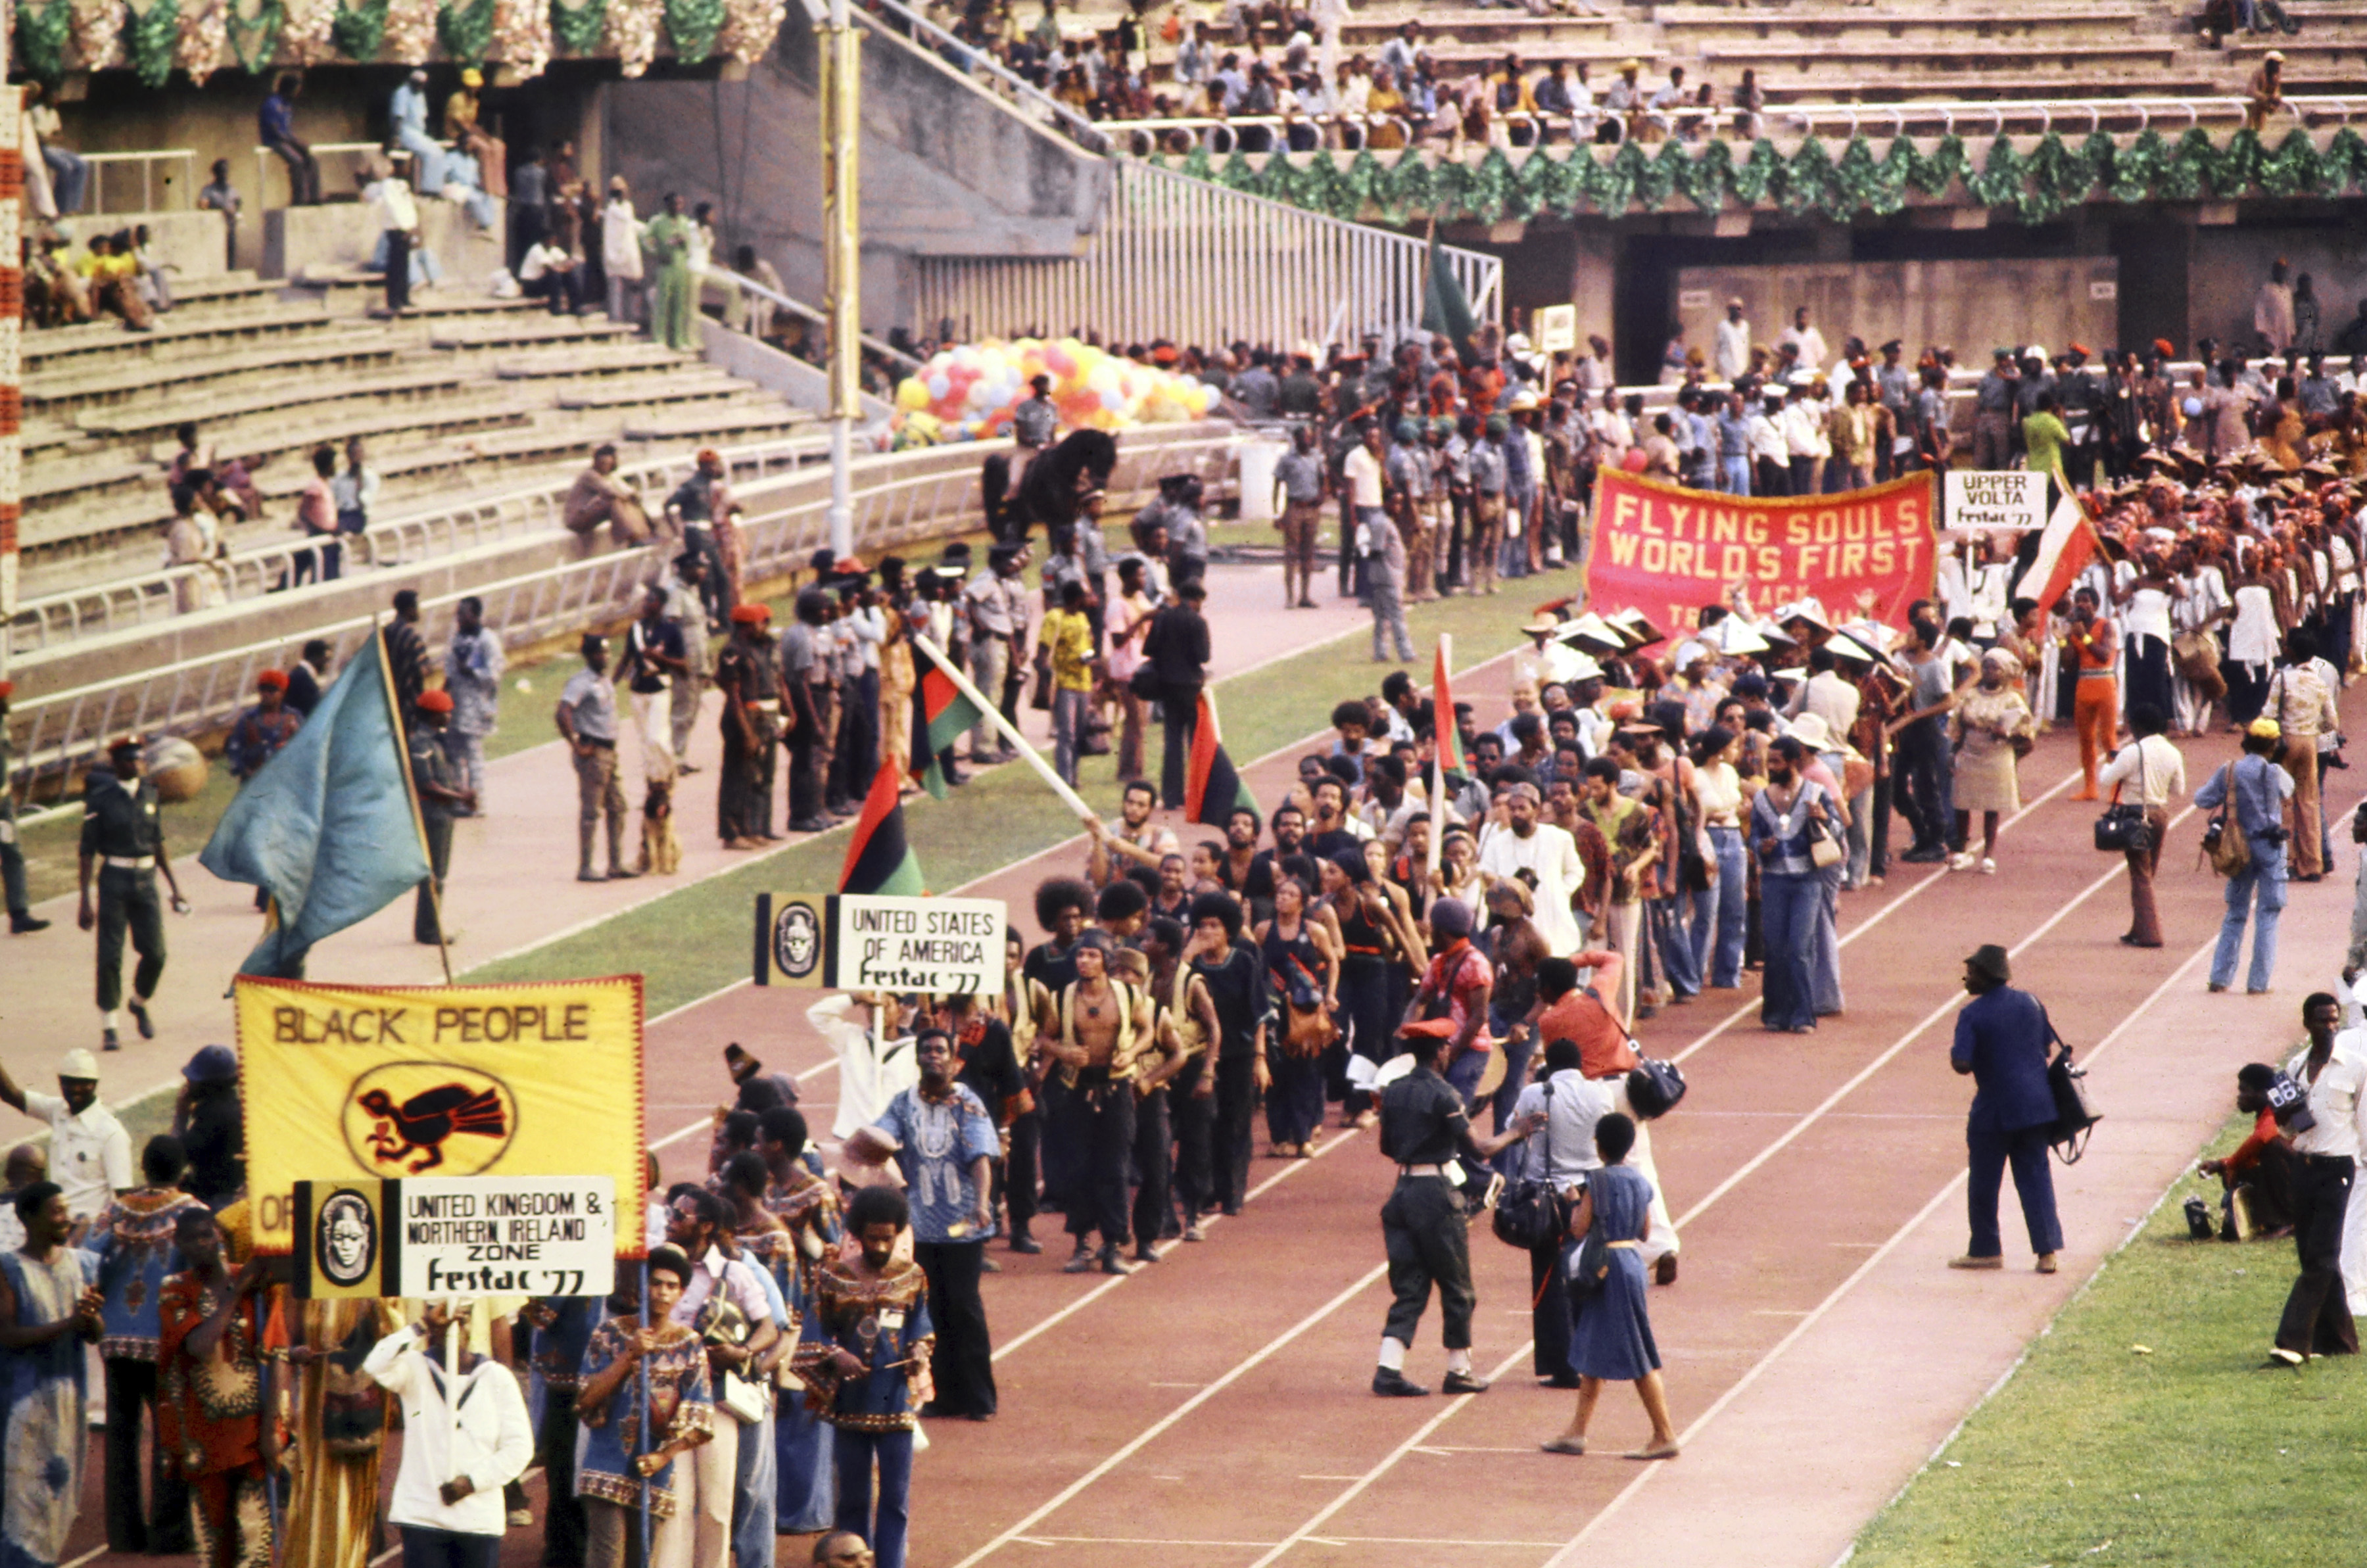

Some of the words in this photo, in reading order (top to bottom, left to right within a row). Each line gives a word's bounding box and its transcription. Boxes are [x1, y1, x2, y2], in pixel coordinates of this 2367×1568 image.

[1963, 475, 2027, 489] UPPER
[1967, 490, 2024, 505] VOLTA
[1613, 492, 1769, 544] FLYING
[1786, 498, 1919, 545] SOULS
[1796, 536, 1923, 579] FIRST
[853, 909, 917, 933] UNITED
[927, 911, 994, 936] STATES
[864, 938, 888, 961] OF
[898, 939, 984, 964] AMERICA
[948, 972, 981, 994] '77
[273, 1005, 406, 1043] BLACK
[433, 1004, 589, 1043] PEOPLE
[408, 1194, 475, 1218] UNITED
[486, 1193, 575, 1216] KINGDOM
[586, 1191, 602, 1214] &
[408, 1221, 498, 1244] NORTHERN
[509, 1218, 585, 1241] IRELAND
[467, 1244, 540, 1261] ZONE
[542, 1270, 585, 1295] '77
